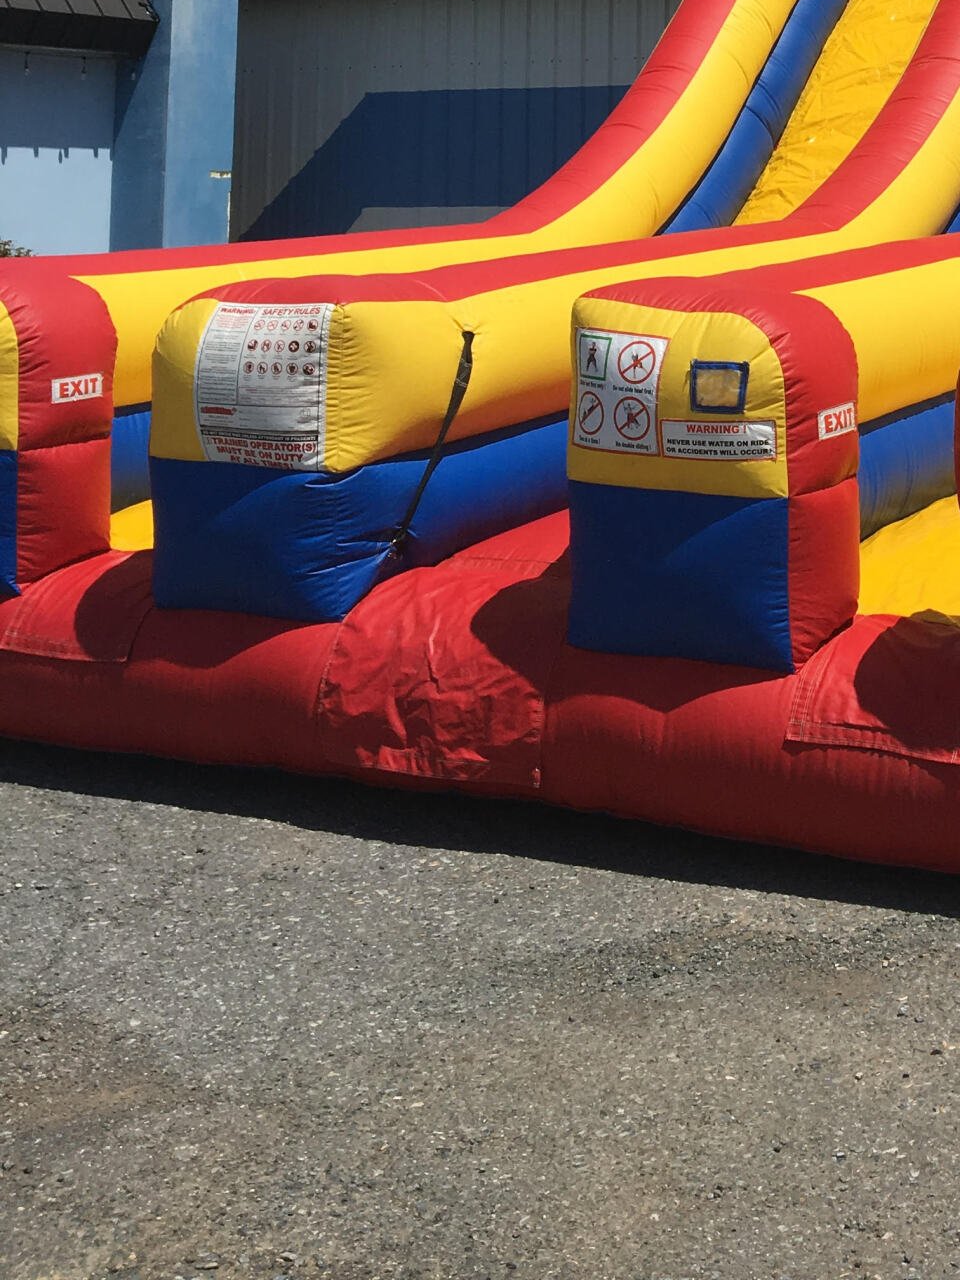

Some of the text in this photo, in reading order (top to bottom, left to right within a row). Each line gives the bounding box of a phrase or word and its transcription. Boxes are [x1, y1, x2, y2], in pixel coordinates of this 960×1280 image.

[263, 306, 321, 316] SAFETY RULES
[59, 377, 98, 398] EXIT
[824, 408, 853, 433] EXIT
[211, 437, 316, 454] TRAINED OPERATOR(S)
[666, 438, 690, 446] NEVER
[692, 439, 706, 447] USE
[217, 446, 304, 462] MUST BE ON DUTY
[678, 448, 718, 456] ACCIDENTS
[243, 457, 259, 465] ALL
